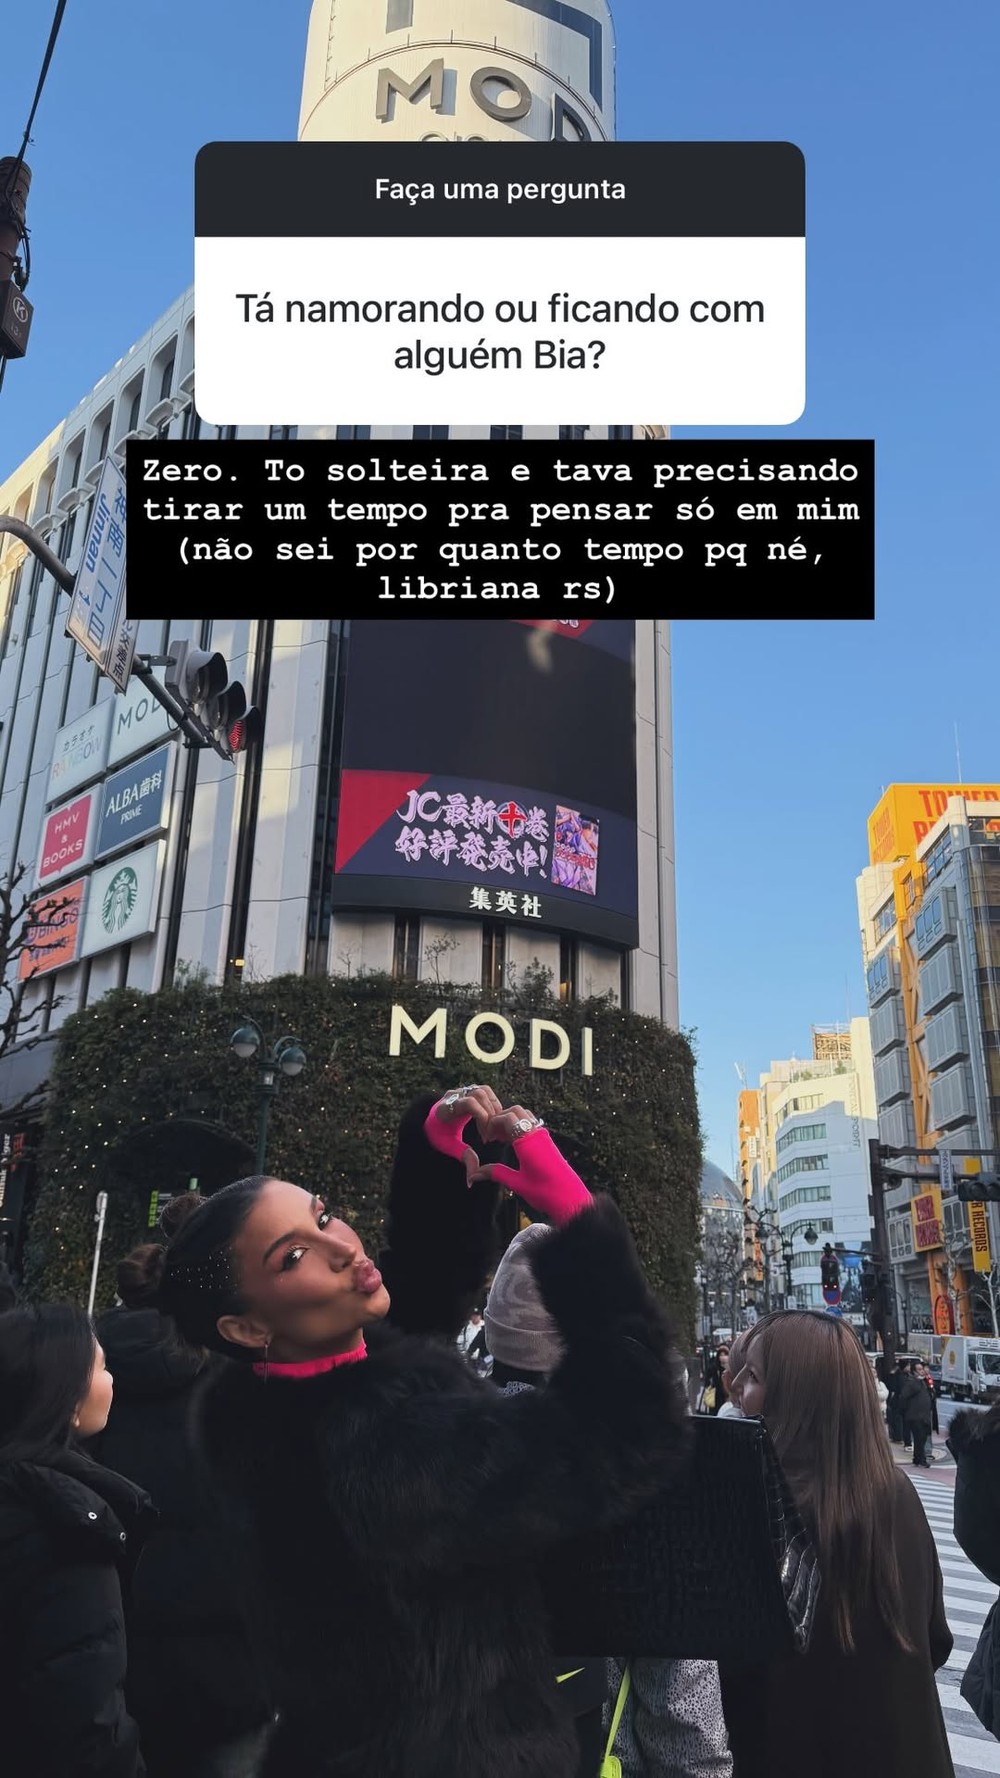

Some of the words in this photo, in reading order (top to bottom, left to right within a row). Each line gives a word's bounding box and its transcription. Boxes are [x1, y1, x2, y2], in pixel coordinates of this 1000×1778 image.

[375, 58, 592, 141] MOD
[86, 493, 110, 574] Jinnan
[54, 812, 80, 834] HMV
[120, 803, 143, 825] PRIME
[42, 838, 84, 868] BOOKS
[469, 886, 542, 918] 集英社
[389, 1005, 593, 1076] MODI
[971, 1210, 988, 1252] RECORDS
